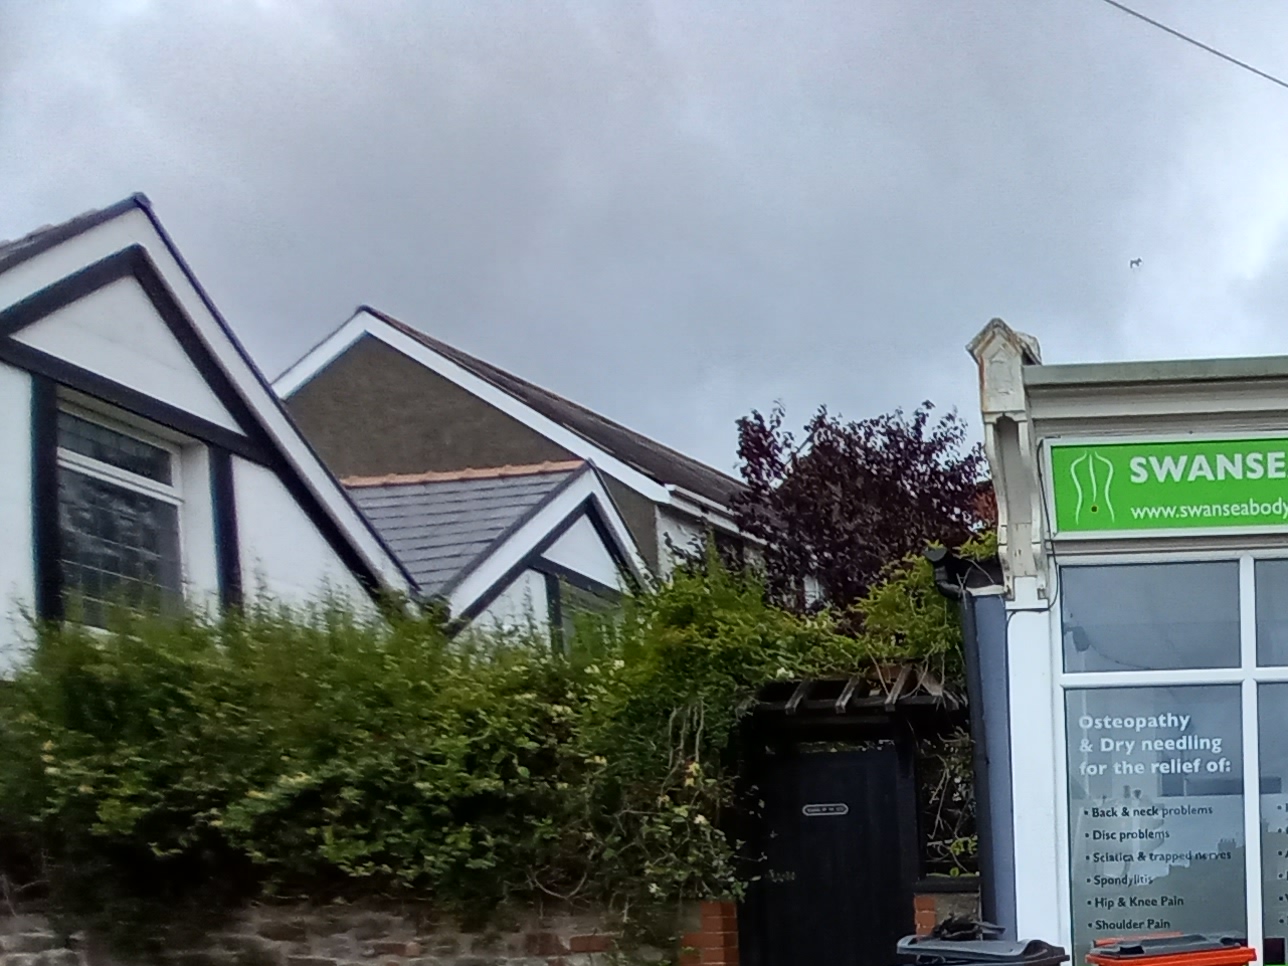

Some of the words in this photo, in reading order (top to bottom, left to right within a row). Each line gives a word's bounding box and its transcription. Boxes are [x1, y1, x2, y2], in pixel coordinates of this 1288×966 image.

[1079, 712, 1191, 731] Osteopathy
[1079, 739, 1093, 752] &
[1100, 738, 1135, 755] Dry
[1141, 736, 1222, 753] needling
[1079, 761, 1107, 776] for
[1113, 761, 1145, 774] the
[1151, 758, 1201, 774] relief
[1206, 757, 1232, 773] of:
[1092, 807, 1118, 818] Back
[1121, 807, 1130, 817] &
[1133, 805, 1159, 816] neck
[1161, 805, 1213, 818] problems
[1093, 830, 1116, 841] Disc
[1119, 829, 1170, 842] problems
[1093, 852, 1134, 863] Sciatica
[1137, 852, 1147, 861] &
[1149, 851, 1193, 865] trapped
[1094, 874, 1154, 888] Spondylitis
[1095, 897, 1114, 911] Hip
[1117, 897, 1127, 907] &
[1129, 896, 1158, 907] Knee
[1161, 895, 1184, 906] Pain
[1095, 919, 1145, 931] Shoulder
[1147, 918, 1171, 930] Pain
